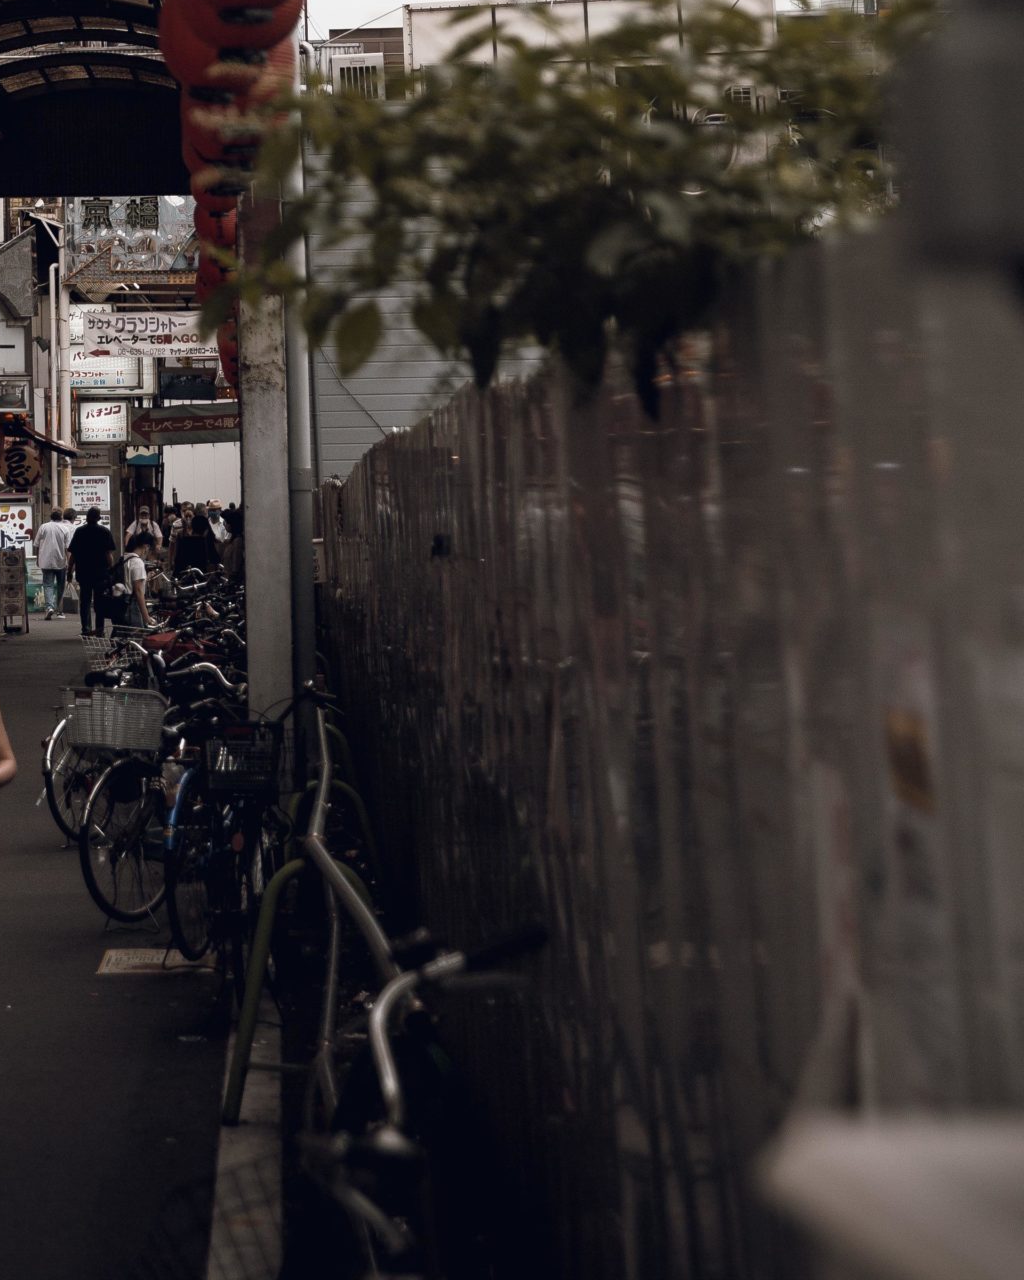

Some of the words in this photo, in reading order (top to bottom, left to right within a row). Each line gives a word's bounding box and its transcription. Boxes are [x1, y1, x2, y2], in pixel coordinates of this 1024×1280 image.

[88, 318, 112, 330] サウナ
[115, 314, 187, 334] グランシャトー
[86, 404, 122, 420] パチンコ
